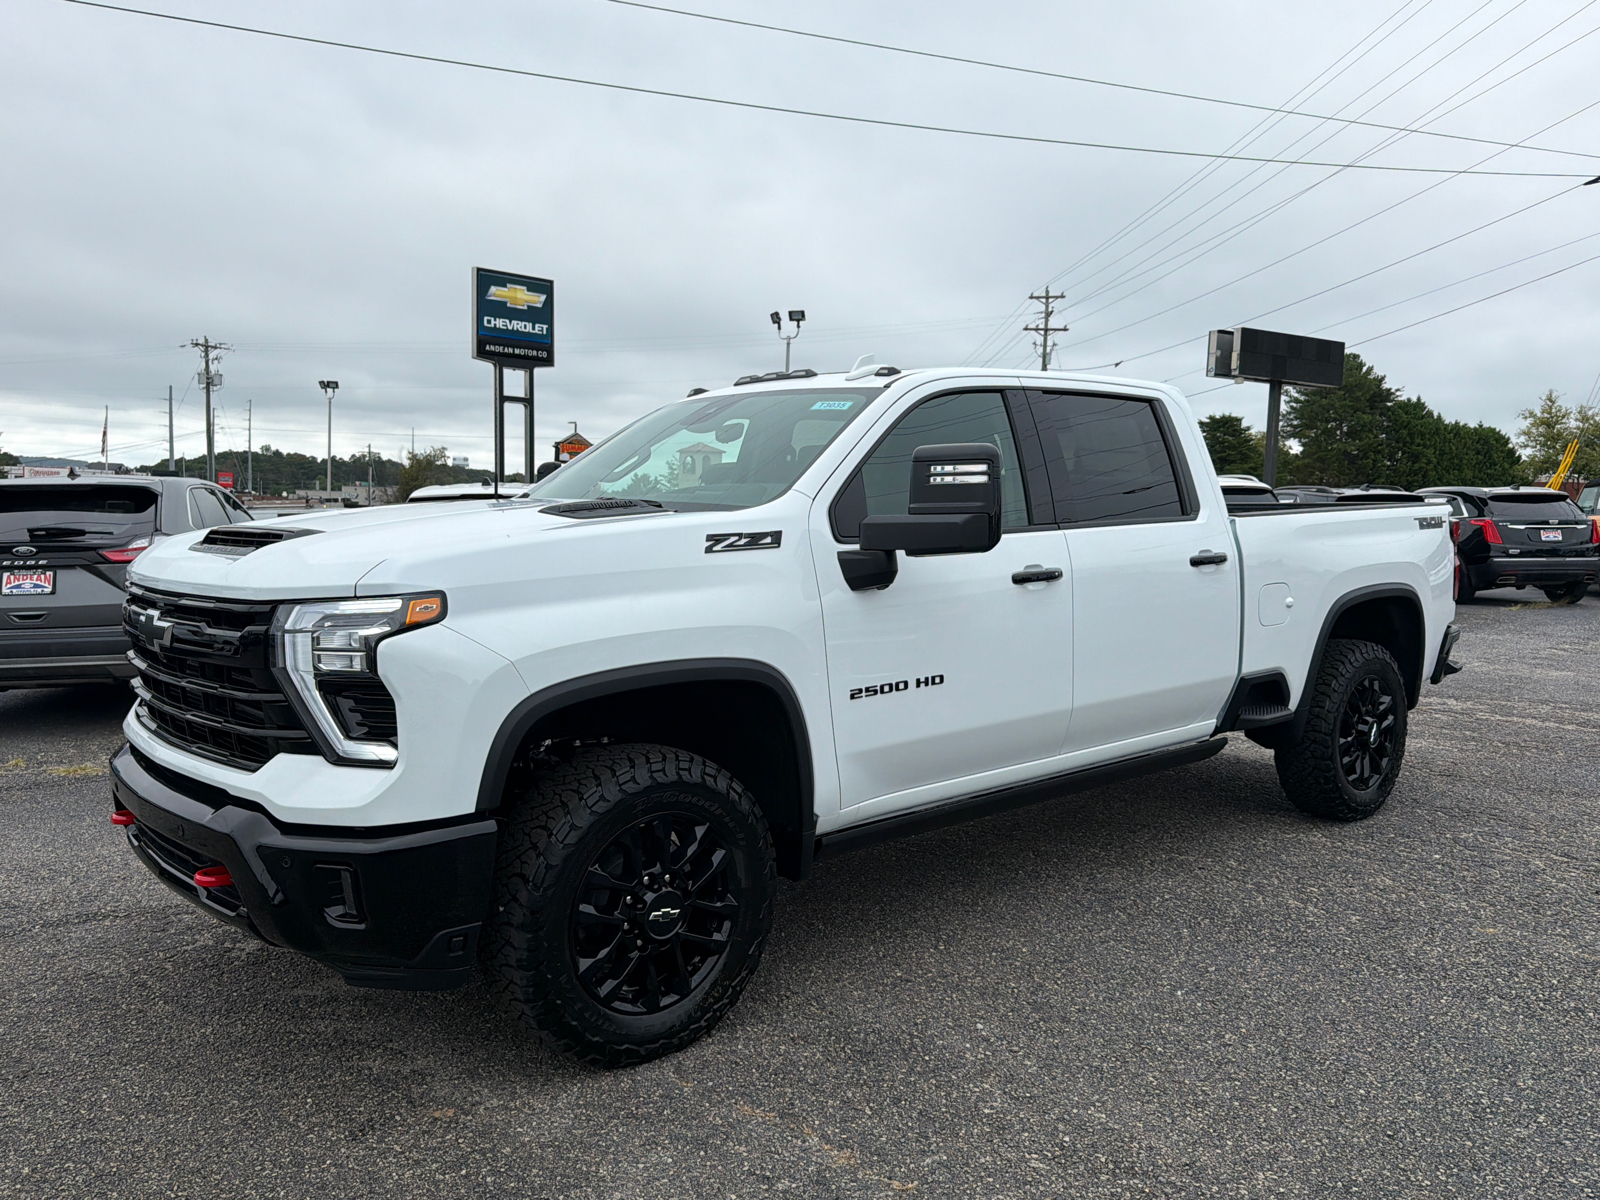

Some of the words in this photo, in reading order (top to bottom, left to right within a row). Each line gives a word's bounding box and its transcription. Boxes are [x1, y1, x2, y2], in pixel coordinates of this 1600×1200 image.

[483, 316, 549, 335] CHEVROLET
[485, 344, 514, 354] ANDEAN
[514, 348, 537, 357] MOTOR
[590, 499, 637, 509] DURAMAX
[4, 573, 52, 588] ANDEAN
[849, 679, 909, 701] 2500
[915, 674, 945, 689] HD
